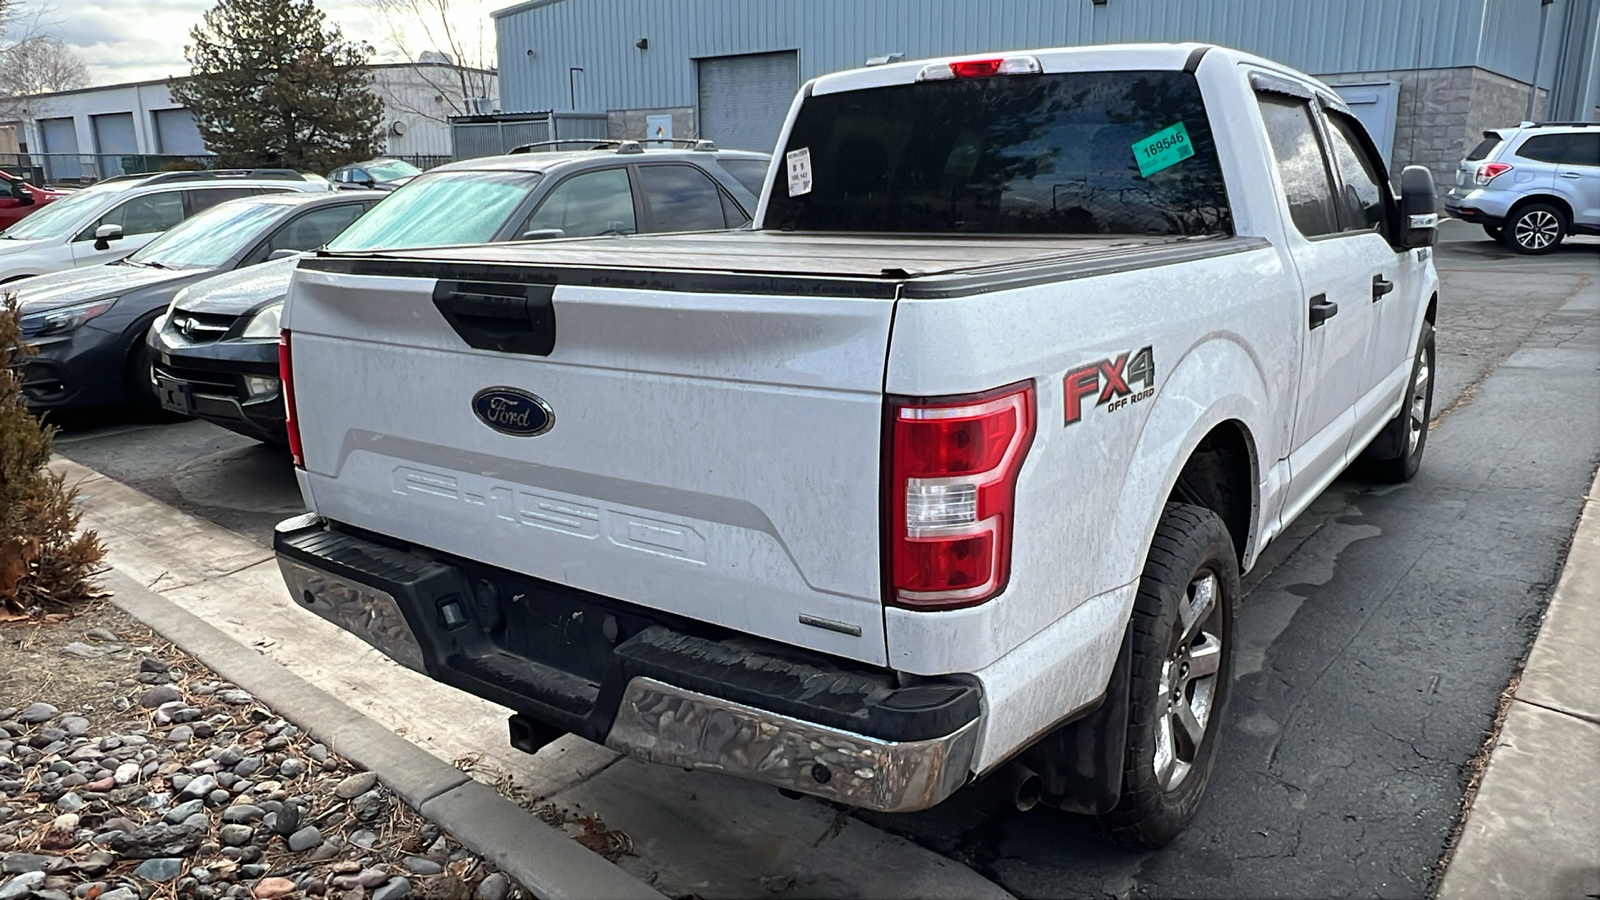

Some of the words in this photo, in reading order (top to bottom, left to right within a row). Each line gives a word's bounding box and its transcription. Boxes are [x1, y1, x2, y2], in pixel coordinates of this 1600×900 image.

[1143, 131, 1184, 158] 169546
[1063, 344, 1155, 428] FX4
[1107, 398, 1128, 413] OFF
[1130, 388, 1154, 404] ROAD
[487, 396, 530, 427] Ford
[392, 465, 706, 566] F-150
